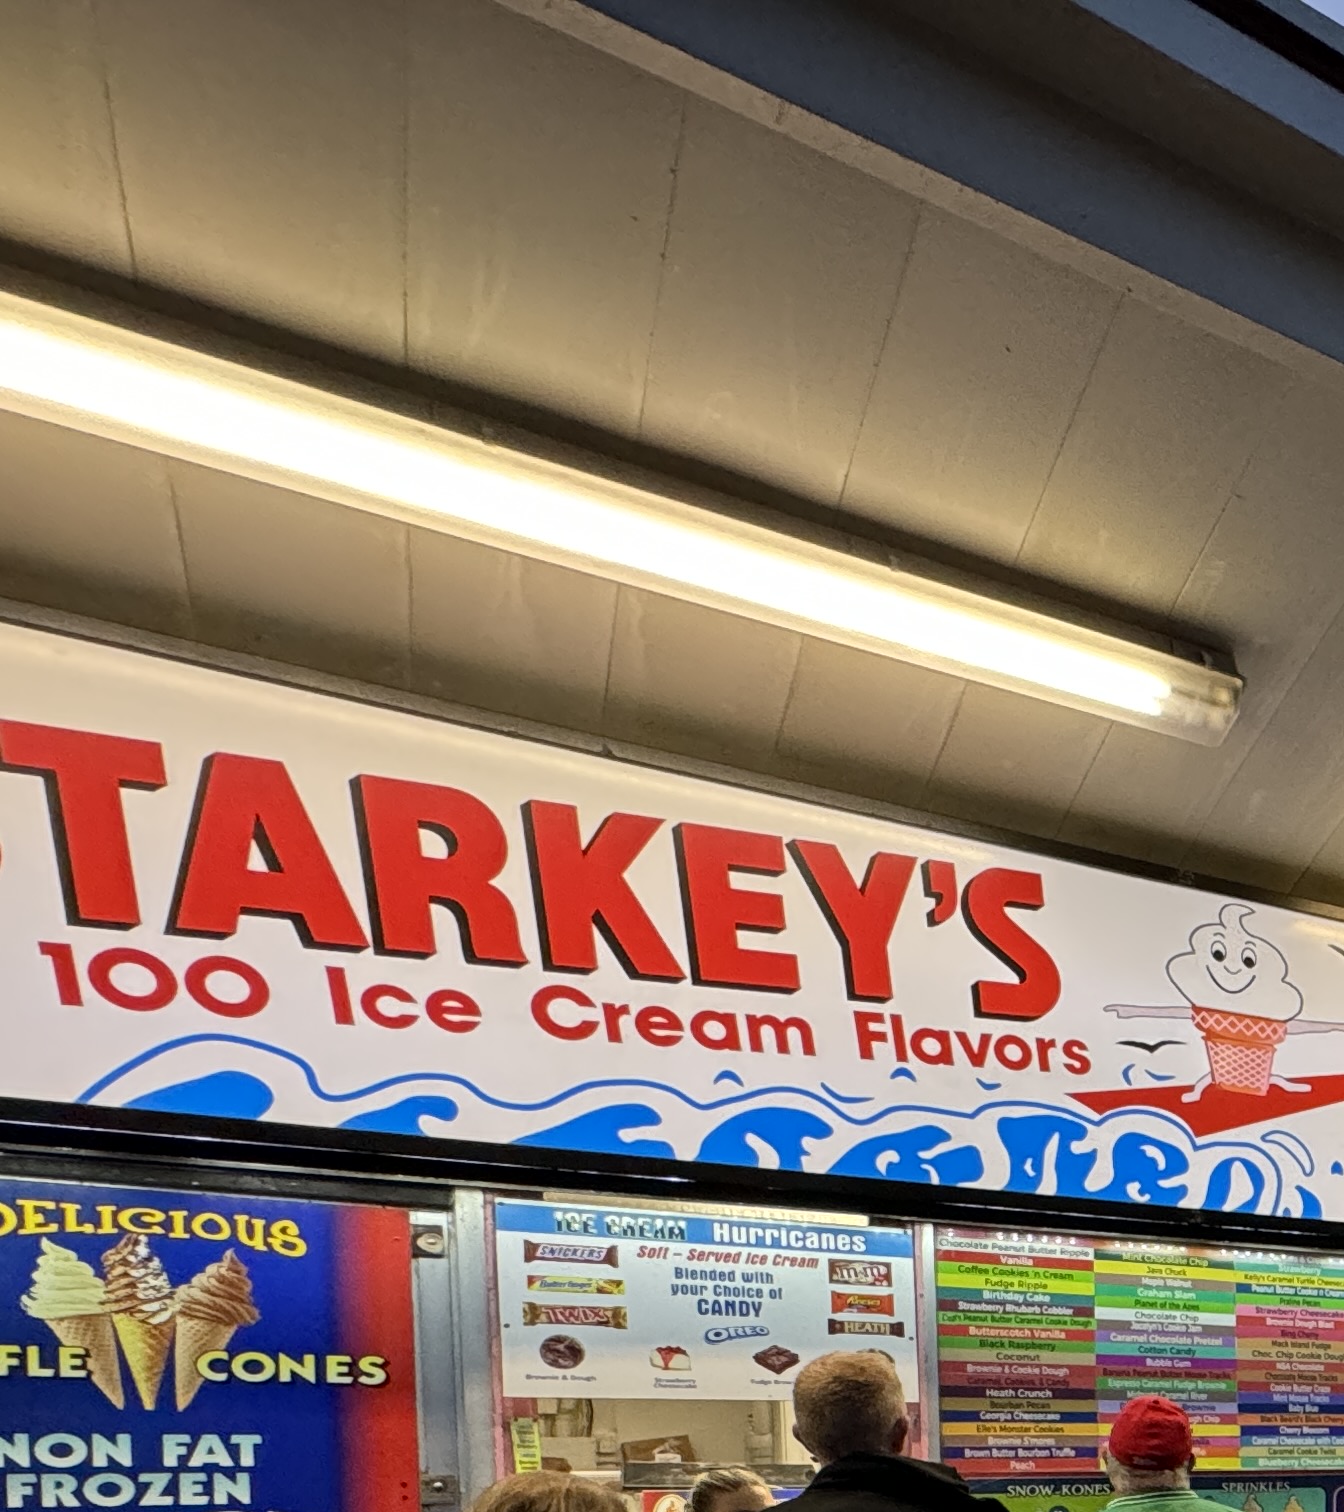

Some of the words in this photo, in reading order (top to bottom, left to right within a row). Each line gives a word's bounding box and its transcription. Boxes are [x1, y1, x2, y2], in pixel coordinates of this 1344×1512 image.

[0, 719, 1061, 1021] TARKEY'S
[39, 942, 270, 1018] 100
[326, 966, 481, 1032] Ice
[530, 985, 816, 1057] Cream
[855, 1011, 1091, 1076] Flavors
[554, 1211, 596, 1234] ICE
[604, 1215, 687, 1240] CREAM
[713, 1222, 866, 1252] Hurricanes
[540, 1245, 604, 1260] SNICKERS
[939, 1238, 988, 1250] Chocolate
[991, 1242, 1025, 1252] Peanut
[1028, 1245, 1057, 1255] Butter
[1060, 1248, 1090, 1259] Ripple
[636, 1245, 670, 1260] Soft
[687, 1248, 742, 1264] Served
[745, 1252, 769, 1266] Ice
[772, 1254, 819, 1269] Cream
[1000, 1255, 1033, 1266] Vanilla
[675, 1267, 735, 1282] Blended
[742, 1271, 774, 1284] with
[958, 1264, 989, 1275] Coffee
[992, 1267, 1029, 1278] Cookies
[1043, 1270, 1074, 1280] Cream
[1267, 1275, 1294, 1283] Caramel
[671, 1284, 708, 1297] your
[713, 1284, 763, 1298] Choice
[769, 1287, 783, 1299] of
[985, 1278, 1014, 1289] Fudge
[1017, 1280, 1048, 1291] Ripple
[983, 1290, 1024, 1303] Birthday
[1026, 1292, 1051, 1302] Cake
[1137, 1288, 1172, 1298] Graham
[1174, 1290, 1196, 1300] Slam
[542, 1306, 609, 1324] TWIX
[697, 1299, 763, 1317] CANDY
[1255, 1306, 1298, 1319] Strawberry
[1300, 1308, 1344, 1318] Cheesecake
[1134, 1311, 1178, 1321] Chocolate
[1180, 1312, 1200, 1323] Chip
[704, 1326, 770, 1344] OREO
[844, 1322, 890, 1336] HEATH
[969, 1326, 1031, 1338] Butterscotch
[1033, 1329, 1066, 1339] Vanilla
[979, 1339, 1005, 1348] Black
[1008, 1340, 1057, 1351] Raspberry
[1110, 1332, 1147, 1342] Caramel
[1149, 1334, 1192, 1344] Chocolate
[996, 1352, 1041, 1361] Coconut
[1138, 1345, 1168, 1355] Cotton
[1169, 1347, 1196, 1357] Candy
[1276, 1350, 1294, 1360] Chip
[1296, 1351, 1322, 1360] Cookie
[0, 1345, 87, 1377] FLE
[196, 1350, 389, 1385] CONES
[986, 1389, 1015, 1398] Heath
[1017, 1389, 1053, 1398] Crunch
[0, 1432, 133, 1468] NON
[162, 1434, 263, 1468] FAT
[1010, 1461, 1036, 1469] Peach
[6, 1472, 251, 1508] FROZEN
[1007, 1483, 1111, 1498] SNOW-KONES
[1222, 1481, 1291, 1493] SPRINKLES
